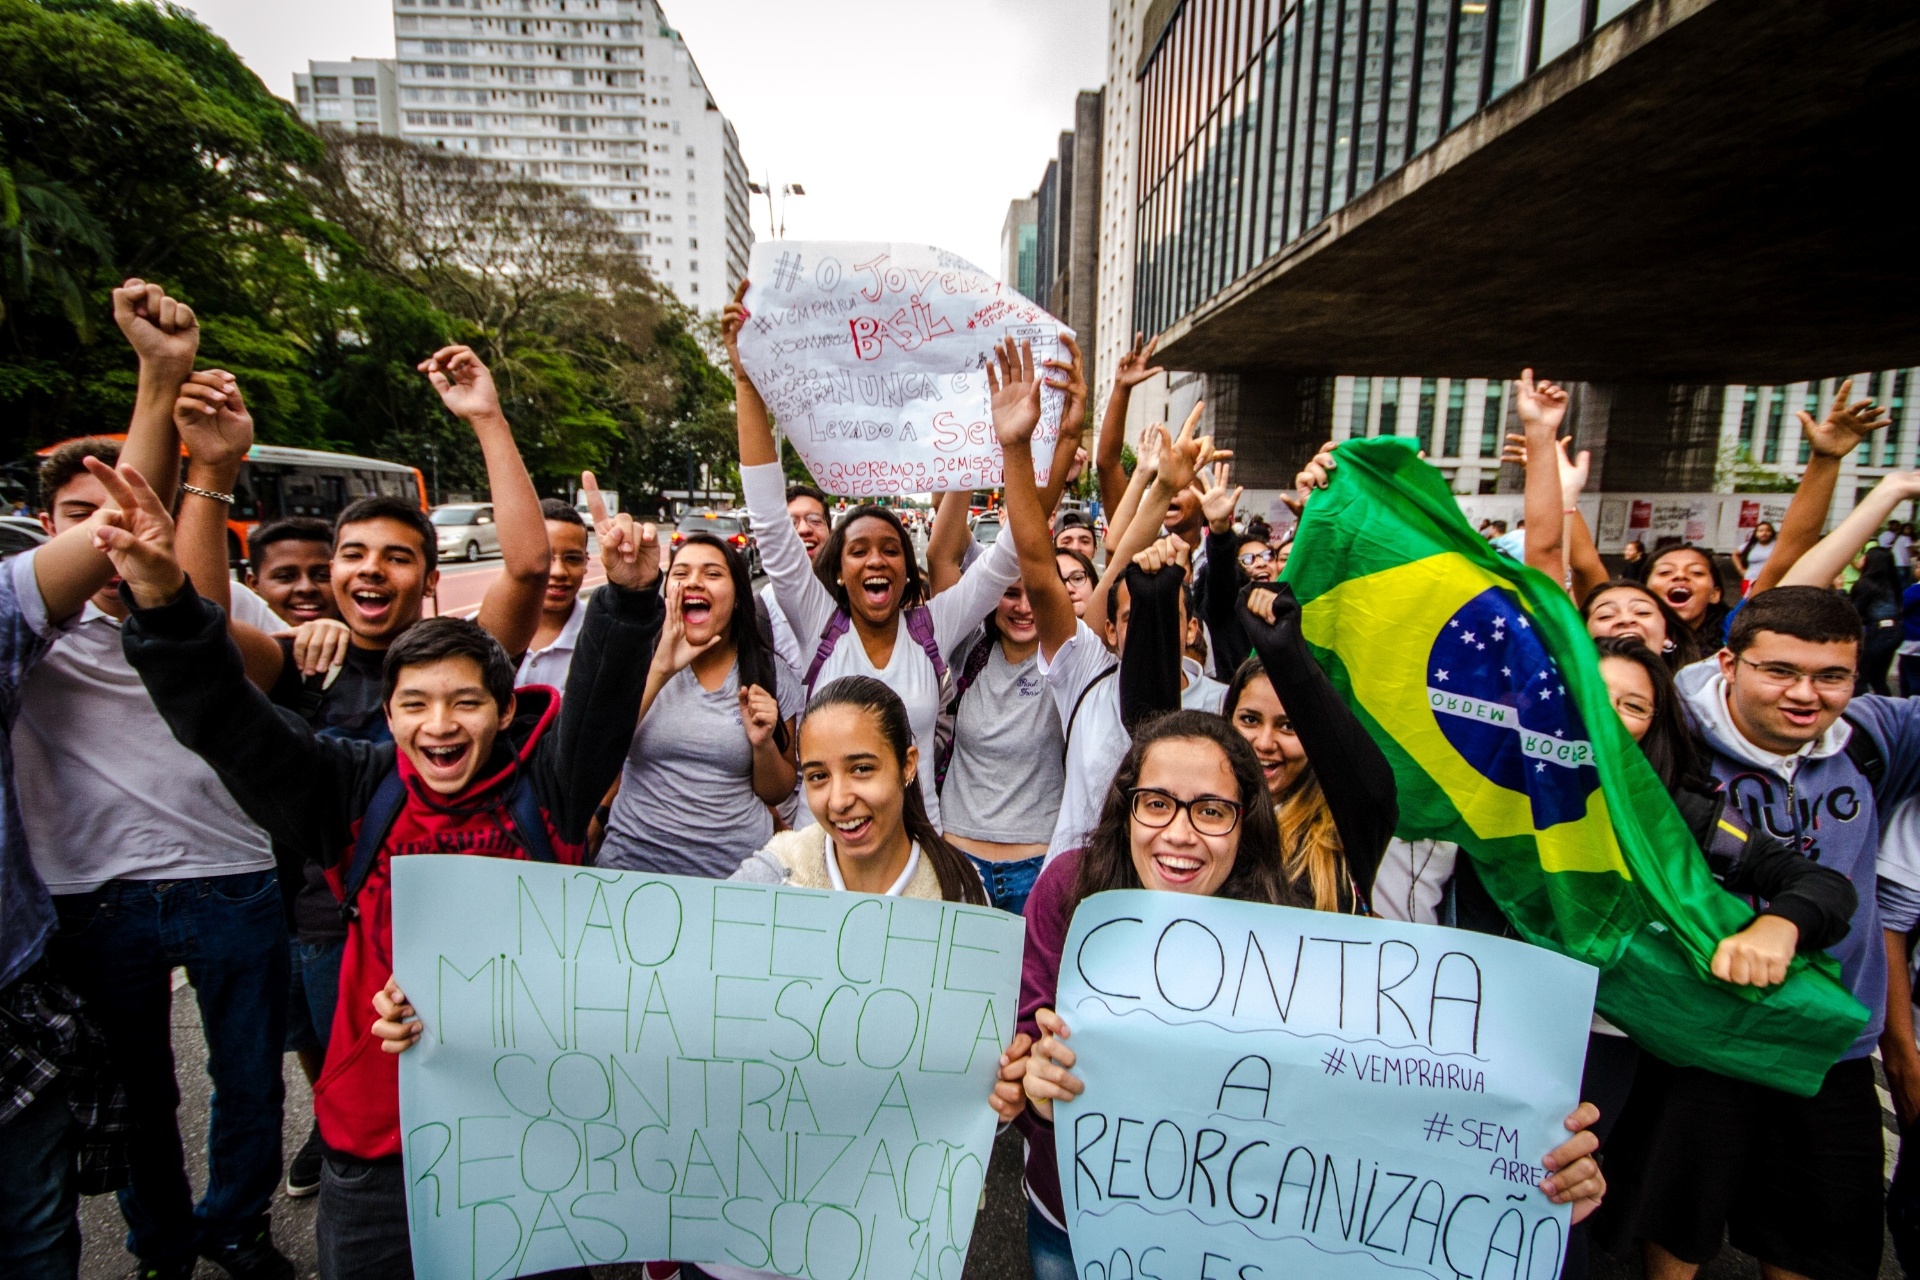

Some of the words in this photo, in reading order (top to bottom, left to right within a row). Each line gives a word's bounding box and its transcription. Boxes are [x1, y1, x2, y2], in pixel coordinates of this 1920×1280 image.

[826, 367, 943, 408] NUNCA
[899, 421, 918, 441] A
[518, 872, 683, 967] NÃO
[710, 885, 1010, 995] FECHE
[1077, 917, 1482, 1054] CONTRA
[713, 974, 1006, 1074] ESCOLA
[493, 1050, 821, 1133] CONTRA
[863, 1070, 920, 1141] A
[1216, 1054, 1272, 1118] A
[1321, 1047, 1486, 1095] #VEMPRARUA
[1423, 1112, 1519, 1160] #SEM
[472, 1191, 629, 1280] DAS
